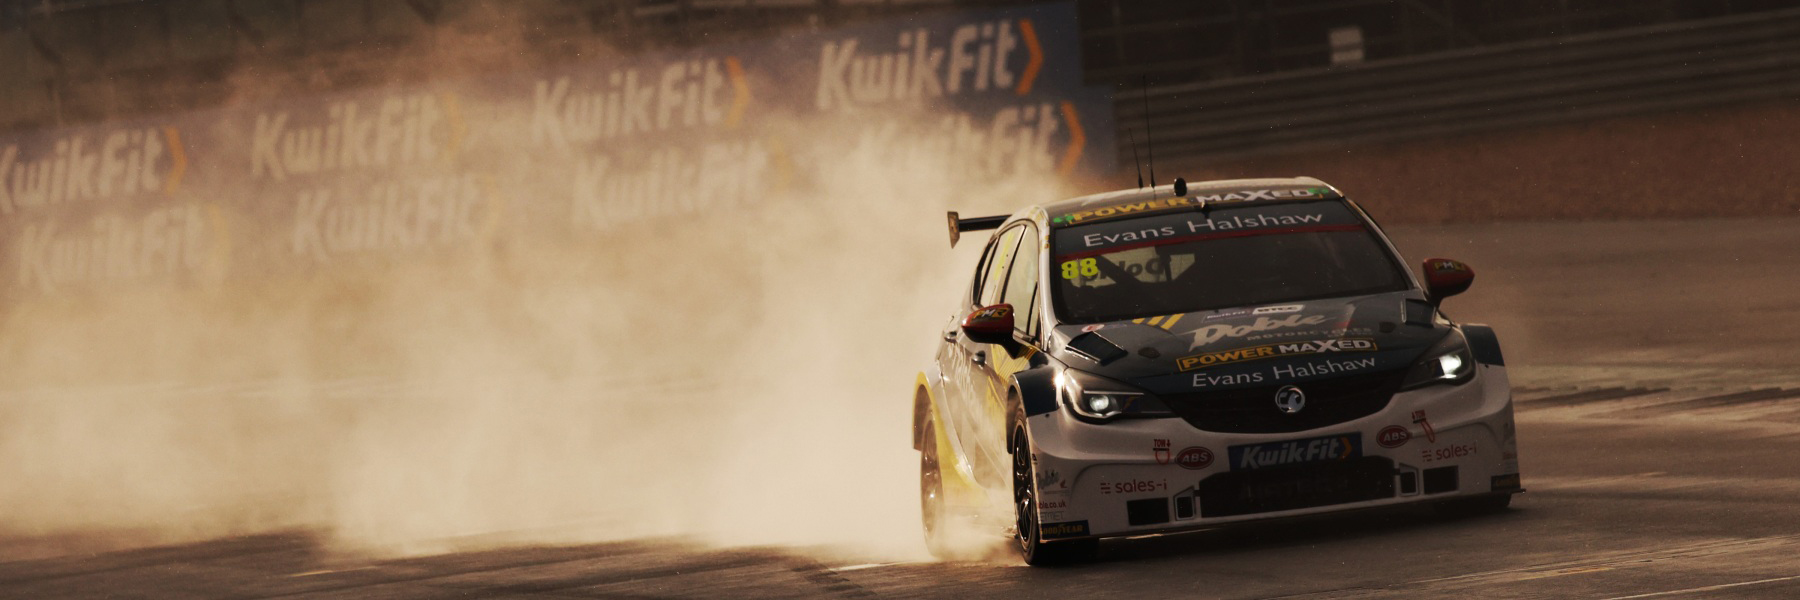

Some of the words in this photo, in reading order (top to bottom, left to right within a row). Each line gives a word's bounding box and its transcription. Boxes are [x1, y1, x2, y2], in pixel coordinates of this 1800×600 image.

[815, 20, 1018, 109] KwikFit
[530, 58, 726, 149] KwikFit
[252, 96, 439, 181] KwikFit
[1070, 197, 1190, 222] POWER
[1195, 189, 1315, 207] MAXED
[1083, 226, 1176, 247] Evans
[1187, 214, 1323, 233] Halshaw
[1061, 257, 1099, 279] 88
[1180, 314, 1336, 352] Doble
[1182, 347, 1275, 369] POWER
[1278, 339, 1372, 354] MAXED
[1192, 372, 1264, 387] Evans
[1272, 358, 1376, 380] Halshaw
[1153, 439, 1166, 448] TOW
[1383, 431, 1407, 443] ABS
[1436, 442, 1477, 460] sales-i
[1181, 452, 1209, 464] ABS
[1240, 438, 1340, 469] KwikFit
[1115, 479, 1167, 494] sales-i
